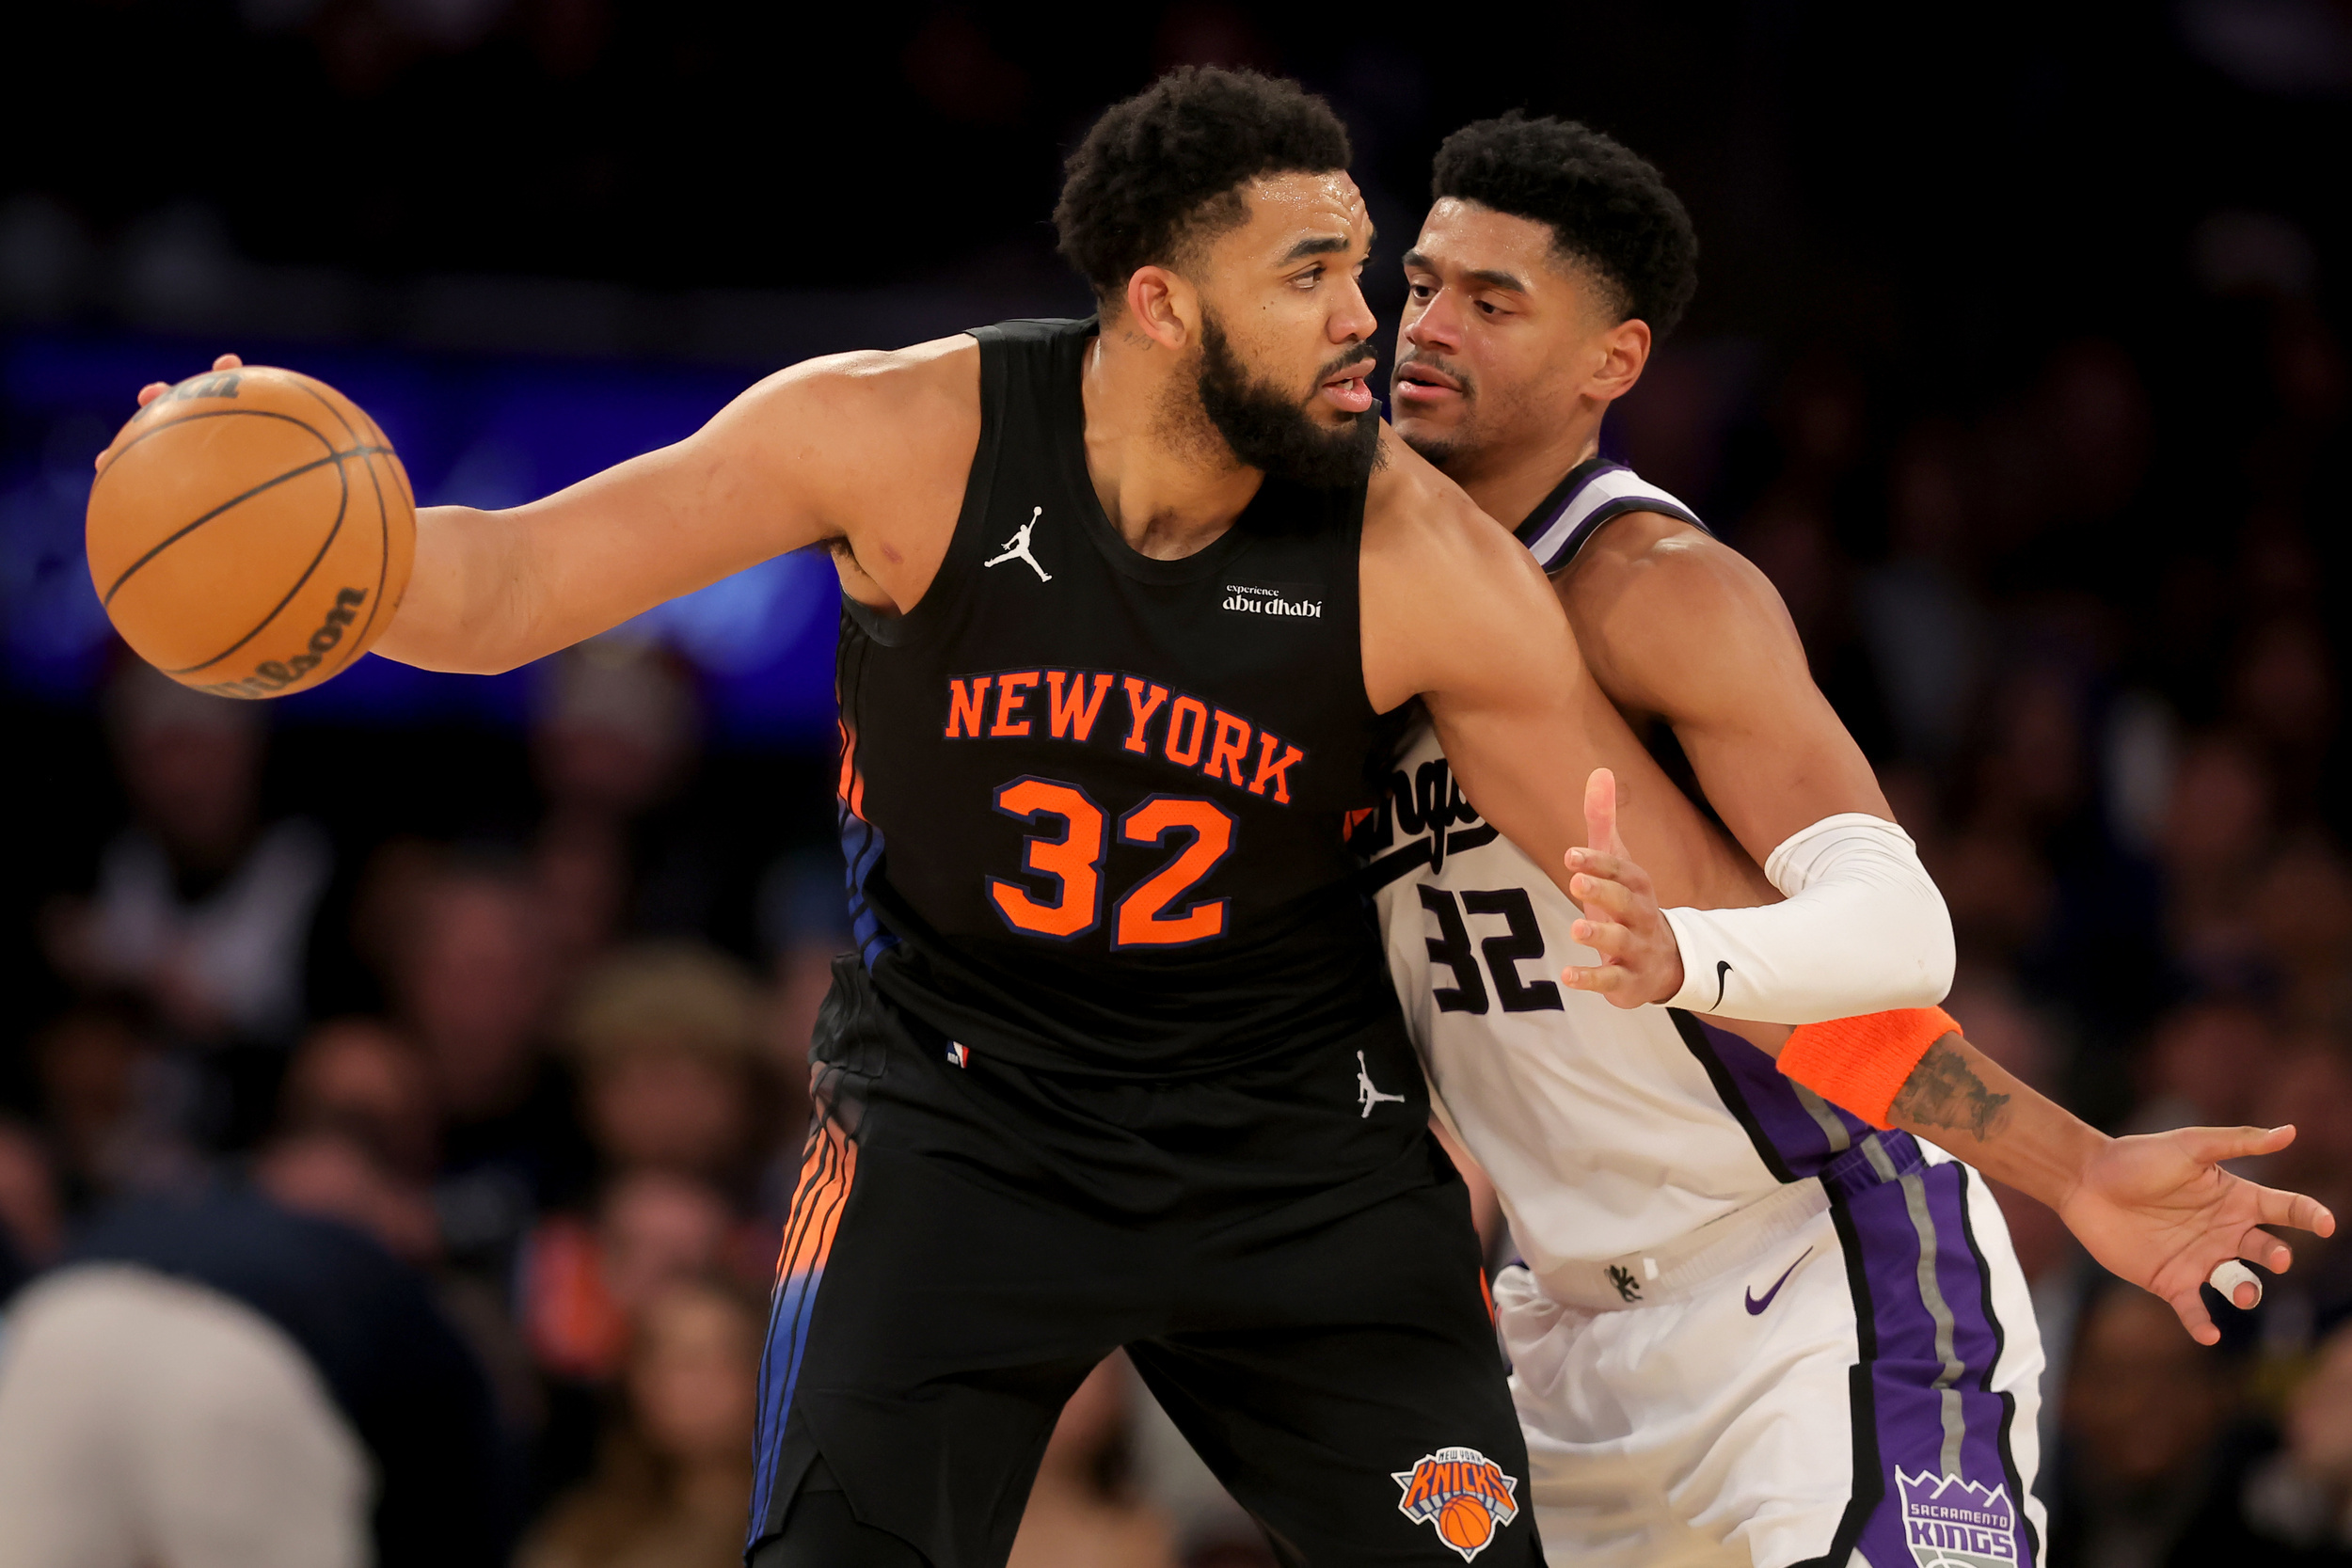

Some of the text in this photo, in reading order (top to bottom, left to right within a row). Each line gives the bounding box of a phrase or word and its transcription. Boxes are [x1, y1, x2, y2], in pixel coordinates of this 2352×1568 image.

[1222, 594, 1323, 618] abu dhabi
[1226, 584, 1279, 597] experience
[944, 669, 1307, 806] NEW YORK
[985, 774, 1240, 952] 32
[1416, 883, 1565, 1015] 32
[1438, 1449, 1483, 1464] NEW YORK
[1403, 1461, 1516, 1512] KNICKS
[1910, 1503, 2009, 1528] SACRAMENTO
[1909, 1520, 2014, 1559] KINGS
